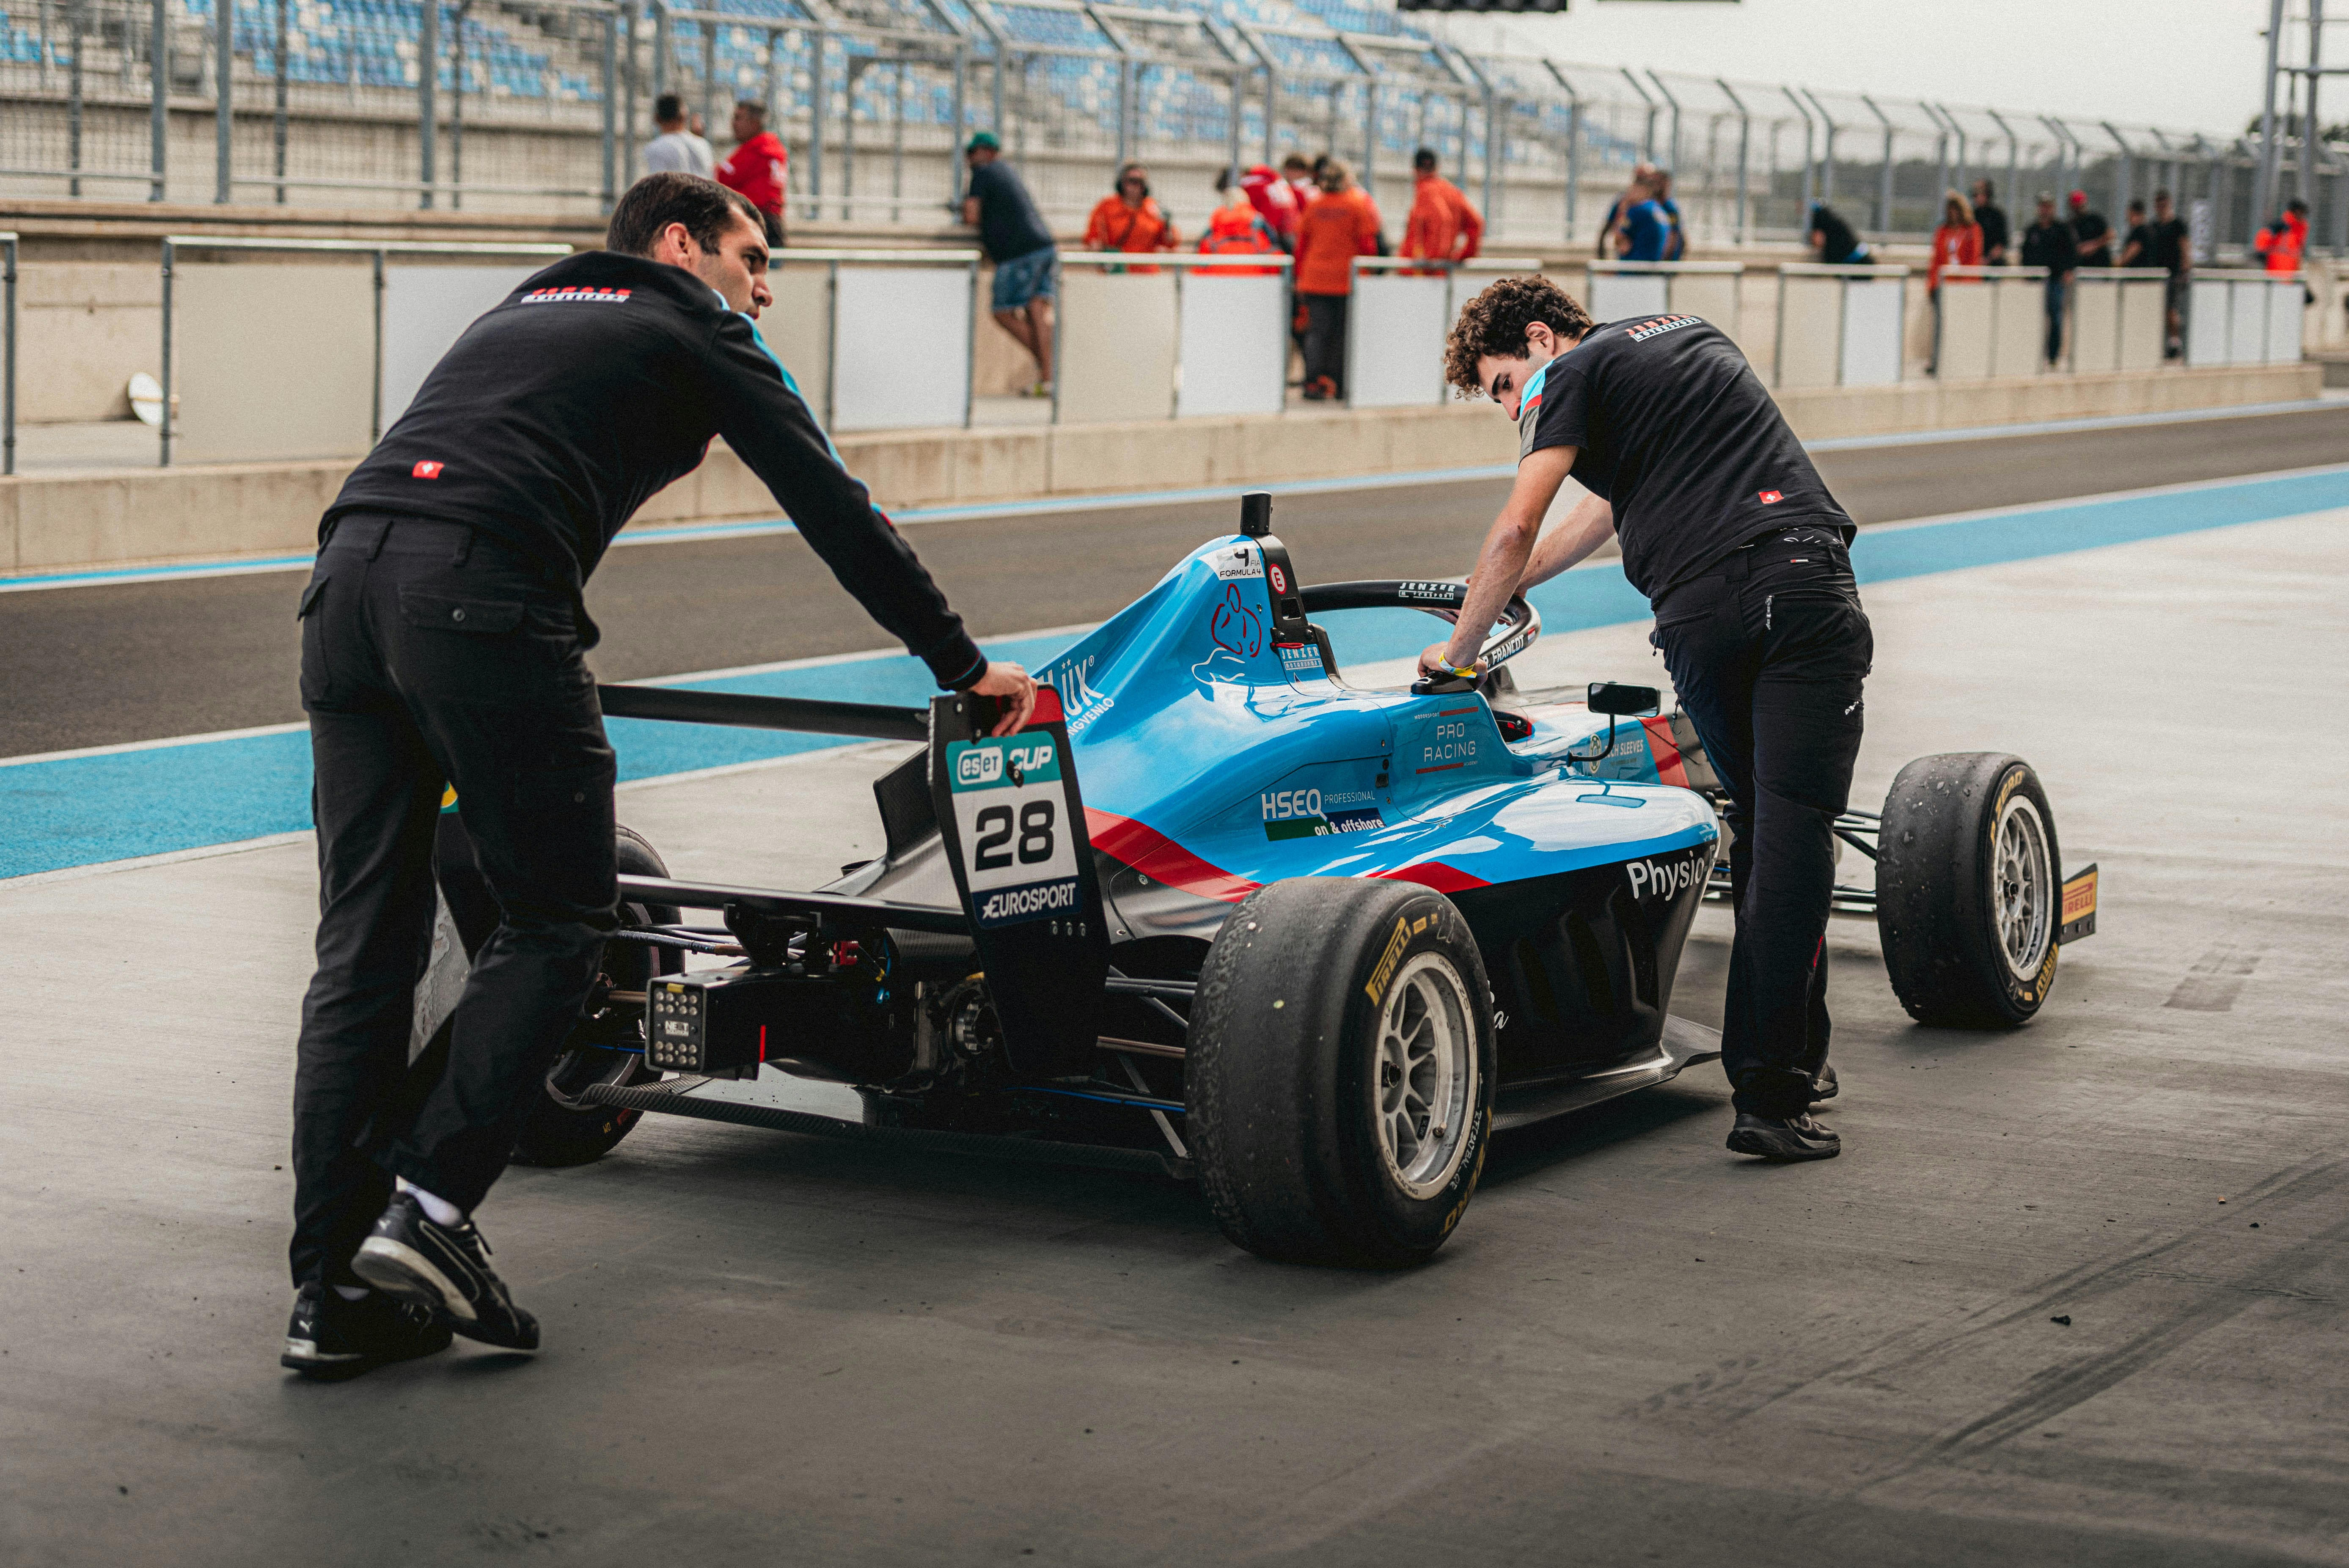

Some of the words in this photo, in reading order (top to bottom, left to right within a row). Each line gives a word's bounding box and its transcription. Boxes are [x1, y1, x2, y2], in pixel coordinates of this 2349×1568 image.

[1220, 569, 1256, 578] FORMULA
[1274, 572, 1283, 587] E
[1400, 582, 1456, 592] JENZER
[1282, 646, 1319, 660] JENZER
[1491, 634, 1524, 665] FRANCOT
[1286, 660, 1321, 668] MOTORSPORT
[1067, 698, 1114, 736] NGVENLO
[1437, 723, 1464, 740] PRO
[1009, 745, 1053, 770] CUP
[1424, 740, 1476, 762] RACING
[1620, 739, 1643, 756] SLEEVES
[1261, 788, 1328, 822] HSEQ
[1325, 791, 1375, 804] PROFESSIONAL
[975, 799, 1055, 872] 28
[1314, 825, 1329, 836] on
[1330, 821, 1342, 834] &
[1341, 818, 1385, 833] offshore
[982, 882, 1076, 920] EUROSPORT
[1365, 917, 1411, 1007] PIRELLI
